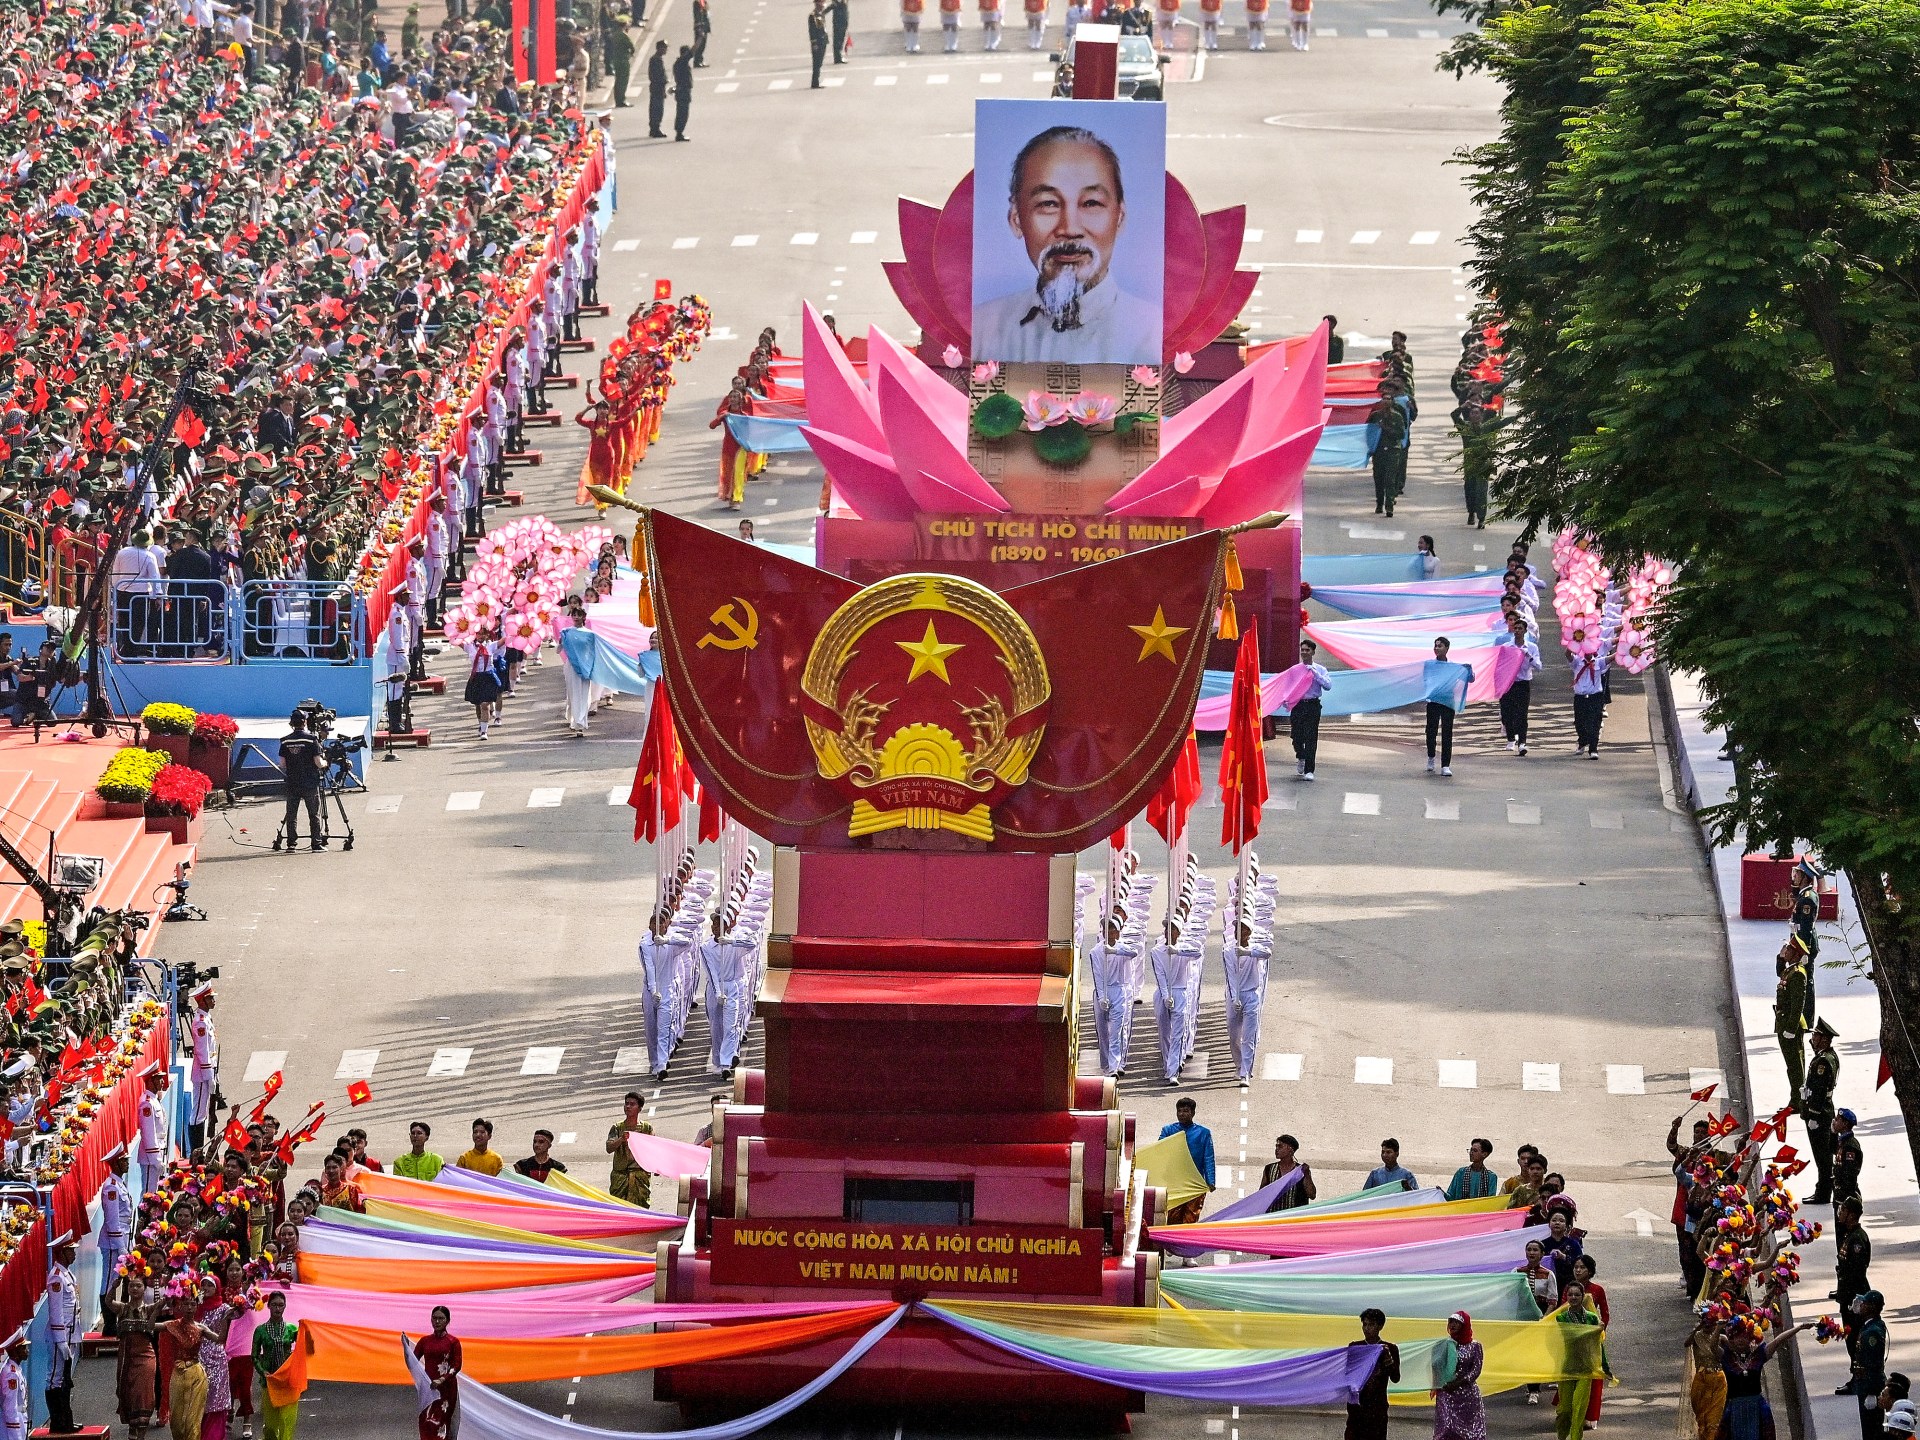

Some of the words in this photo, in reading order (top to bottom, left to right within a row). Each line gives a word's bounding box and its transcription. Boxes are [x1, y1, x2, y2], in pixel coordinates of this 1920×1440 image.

[929, 517, 975, 537] CHỦ
[983, 521, 1035, 541] TỊCH
[1042, 516, 1077, 539] HỒ
[1085, 520, 1121, 540] CHÍ
[1128, 525, 1187, 541] MINH
[991, 546, 1047, 563] (1890
[881, 788, 922, 806] VIỆT
[925, 790, 965, 809] NAM
[734, 1226, 788, 1247] NƯỚC
[793, 1229, 847, 1250] CỘNG
[851, 1230, 894, 1250] HÒA
[900, 1232, 930, 1251] XÃ
[935, 1233, 971, 1255] HỘI
[976, 1233, 1014, 1254] CHỦ
[1020, 1236, 1082, 1256] NGHĨA
[799, 1259, 844, 1281] VIỆT
[850, 1263, 895, 1280] NAM
[900, 1262, 959, 1282] MUÔN
